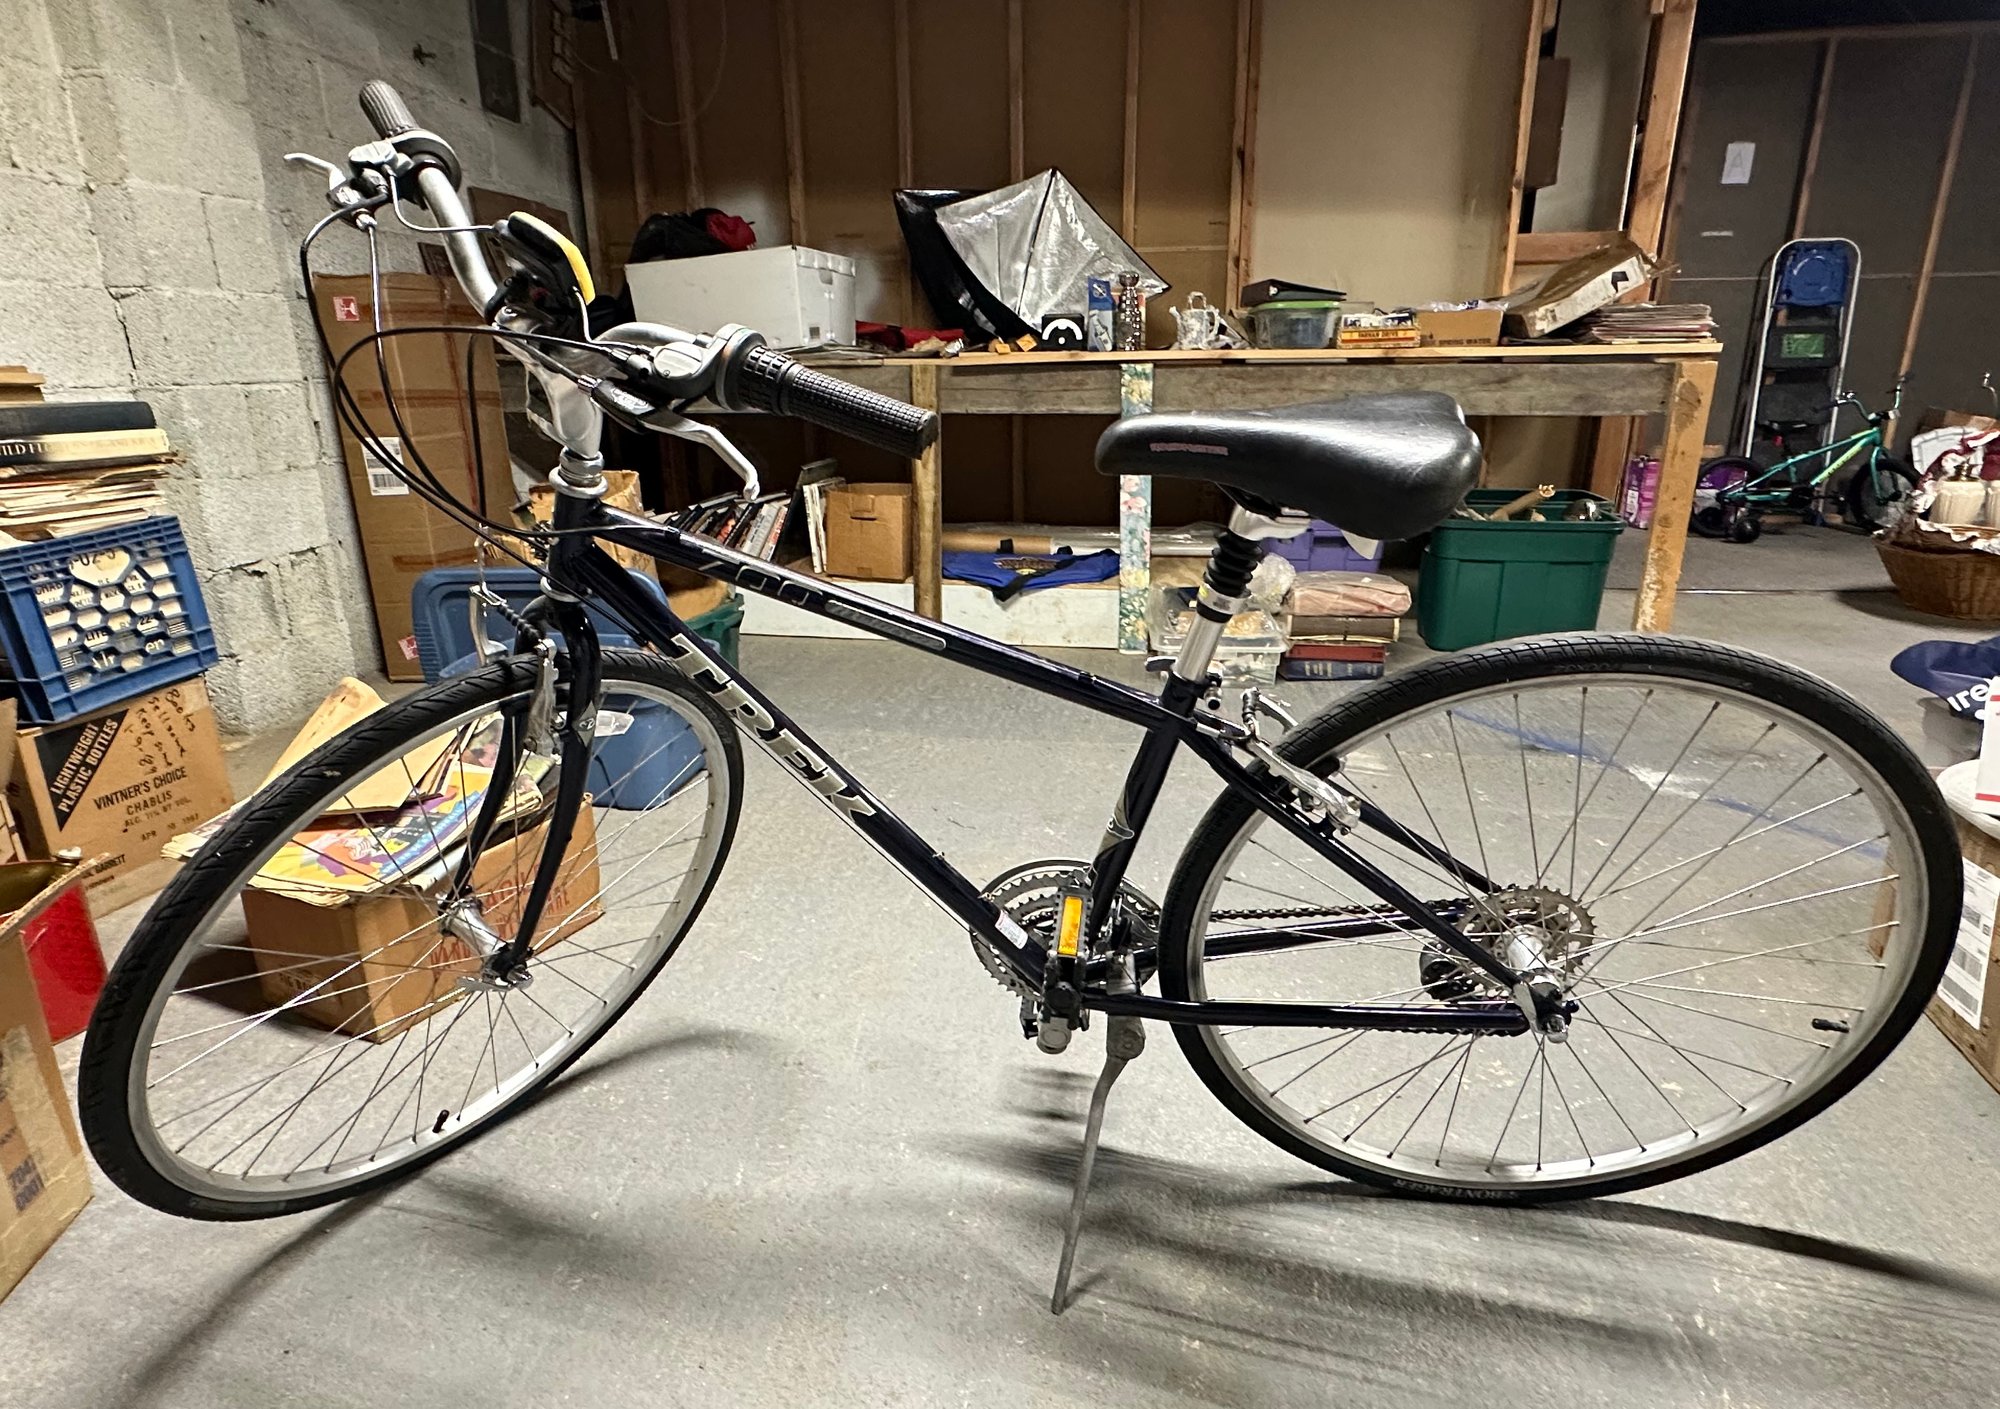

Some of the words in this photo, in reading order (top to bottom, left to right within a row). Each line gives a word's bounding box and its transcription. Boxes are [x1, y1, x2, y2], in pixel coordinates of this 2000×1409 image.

[50, 723, 99, 795] LIGHTWEIGHT
[671, 633, 877, 824] TREK
[58, 766, 92, 813] PLASTIC
[85, 719, 118, 766] BOTTLES
[93, 780, 150, 810] VINTNER'S
[153, 766, 187, 789] CHOICE
[126, 790, 172, 815] CHABLIS
